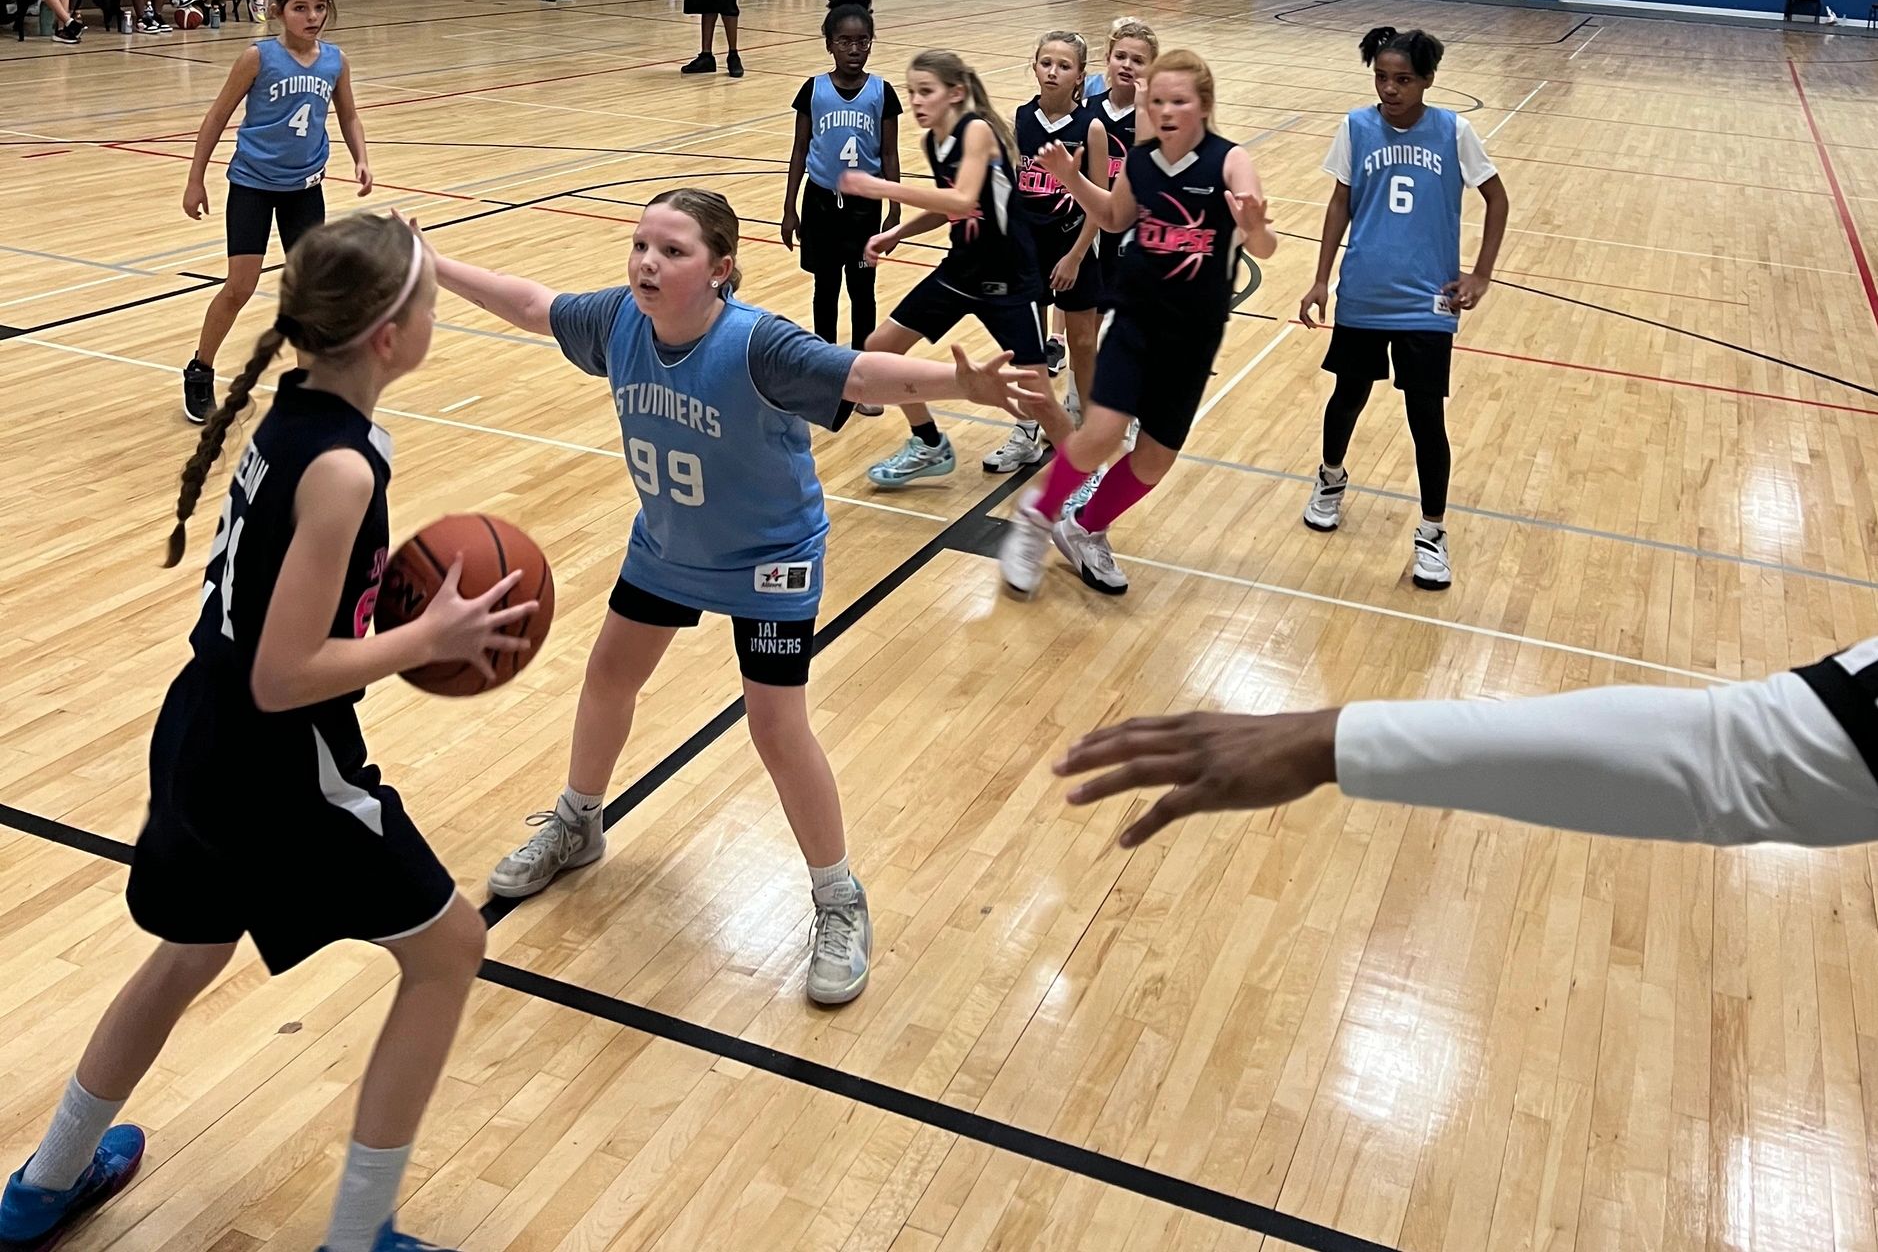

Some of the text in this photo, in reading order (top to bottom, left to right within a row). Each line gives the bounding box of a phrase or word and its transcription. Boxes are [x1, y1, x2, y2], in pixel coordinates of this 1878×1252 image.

[269, 75, 333, 103] STUNNERS
[288, 103, 311, 137] 4
[819, 110, 875, 137] STUNNERS
[840, 136, 859, 168] 4
[1364, 144, 1442, 177] STUNNERS
[1389, 175, 1414, 214] 6
[615, 382, 722, 438] STUNNERS
[628, 437, 705, 506] 99
